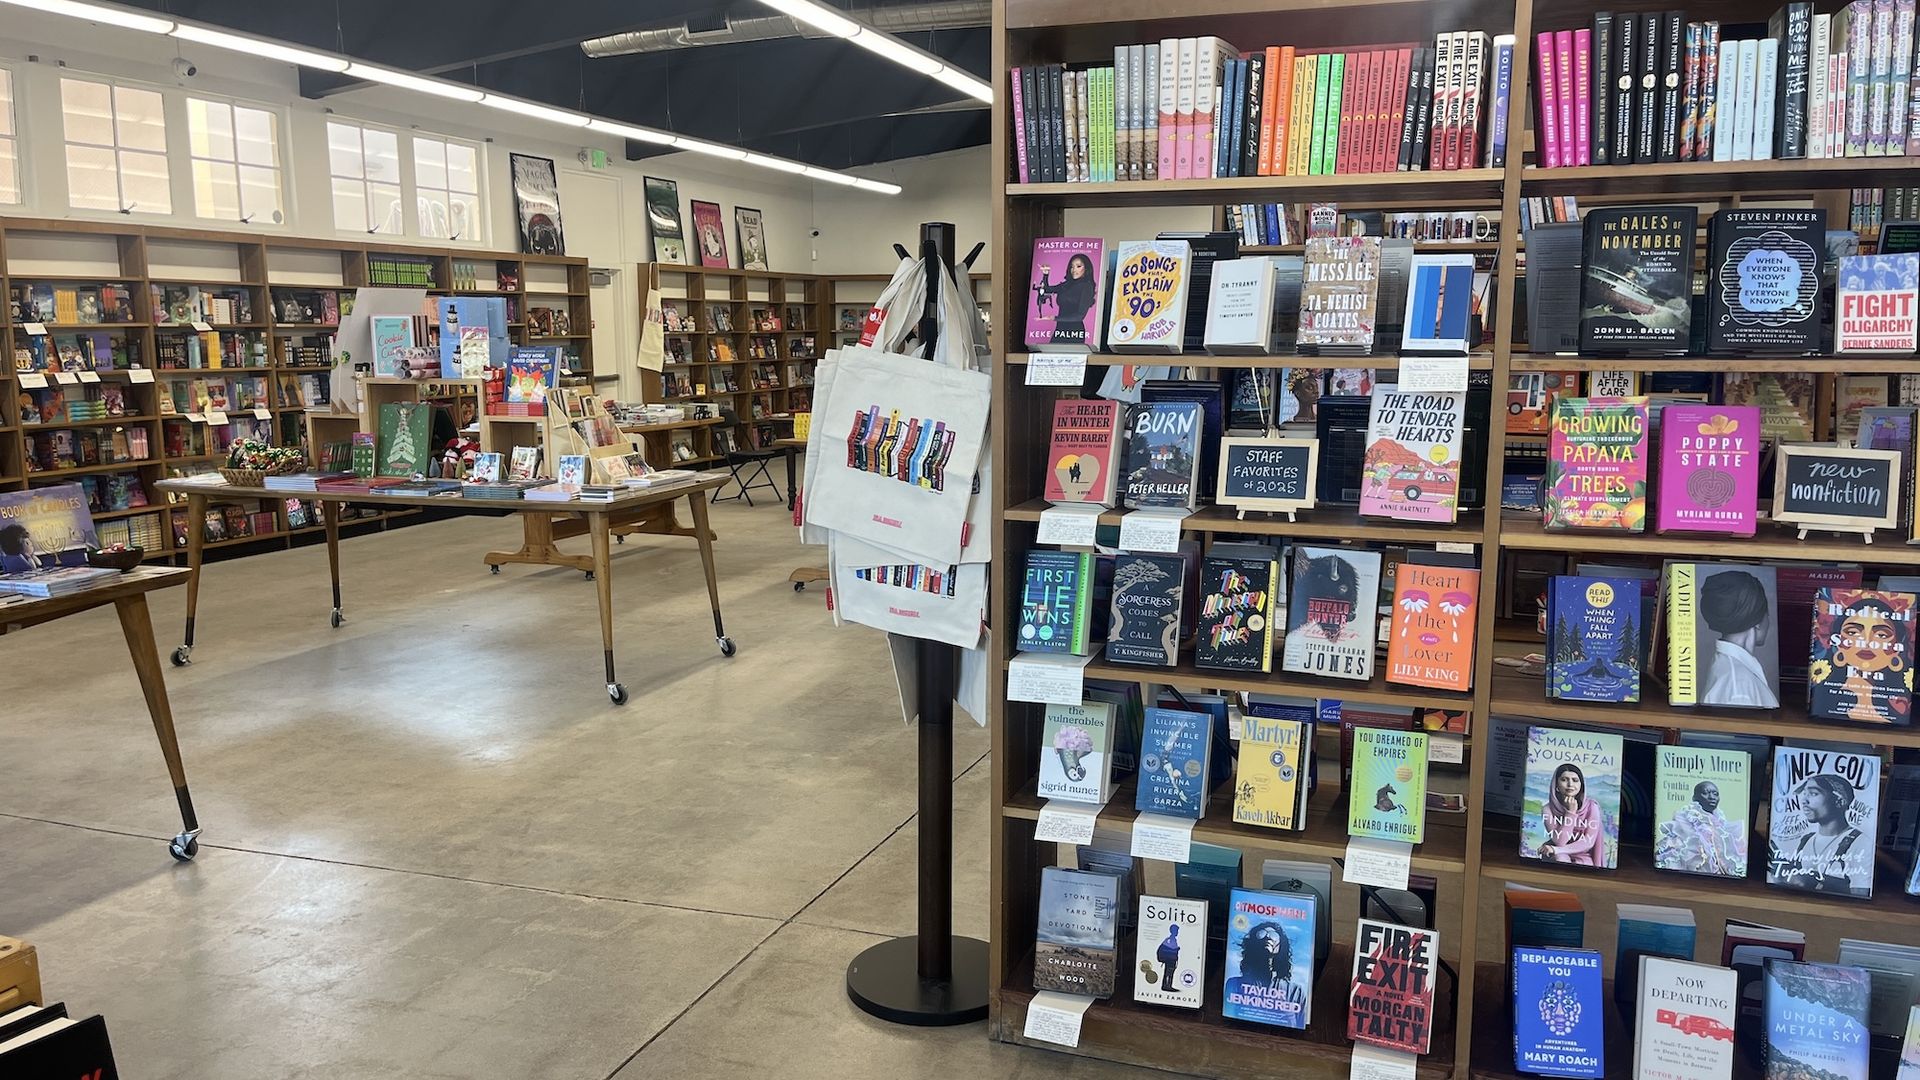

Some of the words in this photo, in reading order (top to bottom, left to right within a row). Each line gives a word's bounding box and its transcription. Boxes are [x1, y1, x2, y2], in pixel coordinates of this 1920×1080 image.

[1788, 21, 1808, 36] GOD
[1622, 47, 1630, 72] PINKER
[1500, 50, 1510, 90] SOLITO
[1604, 222, 1616, 230] THE
[1621, 216, 1668, 230] GALES
[1673, 221, 1682, 230] OF
[1727, 214, 1771, 222] STEVEN
[1775, 214, 1818, 222] PINKER
[1038, 242, 1070, 250] MASTER
[1086, 242, 1098, 250] ME
[1602, 234, 1682, 249] NOVEMBER
[1334, 248, 1349, 260] THE
[1122, 264, 1138, 278] 60
[1140, 256, 1177, 272] SONGS
[1307, 262, 1372, 282] MESSAGE
[1123, 276, 1174, 296] EXPLAIN
[1231, 280, 1258, 288] TYRANNY
[1307, 294, 1368, 312] TA-NEHISI
[1844, 294, 1914, 318] FIGHT
[1149, 318, 1166, 331] ROB
[1314, 312, 1358, 328] COATES
[1843, 319, 1913, 333] OLIGARCHY
[1029, 330, 1051, 338] KEKE
[1054, 330, 1090, 339] PALMER
[1842, 338, 1872, 348] BERNIE
[1874, 338, 1913, 348] SANDERS
[1598, 378, 1629, 388] AFTER
[1600, 388, 1626, 397] CARS
[1382, 394, 1410, 408] THE
[1412, 394, 1454, 411] ROAD
[1057, 418, 1070, 428] IN
[1070, 418, 1110, 428] WINTER
[1136, 410, 1196, 434] BURN
[1376, 410, 1396, 424] TO
[1399, 410, 1456, 428] TENDER
[1558, 415, 1642, 434] GROWING
[1054, 433, 1080, 442] KEVIN
[1081, 434, 1108, 443] BARRY
[1396, 426, 1454, 443] HEARTS
[1682, 436, 1744, 450] POPPY
[1246, 450, 1284, 463] STAFF
[1562, 445, 1634, 464] PAPAYA
[1682, 454, 1742, 468] STATE
[1233, 465, 1298, 479] FAVORITES
[1808, 462, 1876, 478] new
[1128, 484, 1154, 494] PETER
[1156, 484, 1188, 495] HELLER
[1570, 475, 1626, 494] TREES
[1792, 480, 1880, 506] nonfiction
[0, 504, 26, 519] BOOK
[1026, 568, 1074, 582] FIRST
[1412, 570, 1461, 589] Heart
[1808, 572, 1846, 580] MARSHA
[1024, 584, 1072, 609] LIE
[1588, 588, 1610, 596] READ
[1677, 569, 1692, 618] ZADIE
[1119, 593, 1172, 607] SORCERESS
[1308, 600, 1349, 612] BUFFALO
[1590, 596, 1610, 604] THIS
[1022, 610, 1070, 625] WINS
[1128, 608, 1160, 618] COMES
[1586, 608, 1615, 616] WHEN
[1828, 604, 1910, 622] Radical
[1417, 613, 1446, 630] the
[1584, 616, 1616, 624] THINGS
[1590, 624, 1609, 632] FALL
[1130, 631, 1152, 640] CALL
[1586, 632, 1613, 640] APART
[1122, 648, 1164, 660] KINGFISHER
[1404, 644, 1453, 664] Lover
[1304, 652, 1365, 676] JONES
[1678, 646, 1692, 696] SMITH
[1394, 663, 1422, 676] LILY
[1424, 668, 1460, 681] KING
[1846, 666, 1884, 680] Era
[1068, 706, 1084, 716] the
[1048, 714, 1105, 728] vulnerables
[1156, 718, 1196, 729] LILIANA'S
[1150, 728, 1200, 740] INVINCIBLE
[1243, 719, 1300, 749] Martyr!
[1359, 732, 1374, 743] YOU
[1376, 732, 1412, 747] DREAMED
[1414, 737, 1424, 748] OF
[1156, 739, 1192, 750] SUMMER
[1546, 736, 1603, 751] MALALA
[1373, 747, 1406, 760] EMPIRES
[1534, 748, 1614, 766] YOUSAFZAI
[1663, 752, 1706, 778] Simply
[1710, 754, 1742, 774] More
[1150, 776, 1190, 786] CRISTINA
[1776, 752, 1828, 796] ONLY
[1834, 754, 1874, 791] GOD
[1040, 780, 1068, 793] sigrid
[1068, 784, 1098, 796] nunez
[1154, 786, 1184, 796] RIVERA
[1663, 780, 1690, 792] Cynthia
[1154, 798, 1182, 808] GARZA
[1542, 814, 1598, 830] FINDING
[1544, 830, 1562, 840] MY
[1566, 832, 1594, 844] WAY
[1064, 893, 1090, 902] STONE
[1066, 908, 1086, 916] YARD
[1146, 906, 1197, 924] Solito
[1236, 902, 1307, 920] ATMOSPHERE
[1048, 921, 1103, 934] DEVOTIONAL
[1360, 924, 1432, 965] FIRE
[1048, 958, 1097, 970] CHARLOTTE
[1521, 953, 1598, 968] REPLACEABLE
[1060, 974, 1085, 984] WOOD
[1358, 956, 1428, 996] EXIT
[1548, 967, 1572, 978] YOU
[1675, 976, 1706, 990] NOW
[1242, 984, 1286, 1000] TAYLOR
[1652, 988, 1728, 1010] DEPARTING
[1227, 994, 1274, 1010] JENKINS
[1274, 1000, 1301, 1014] REID
[1353, 995, 1425, 1022] MORGAN
[1784, 1010, 1836, 1026] UNDER
[1844, 1016, 1854, 1030] A
[1353, 1012, 1424, 1045] TALTY
[1775, 1022, 1824, 1039] METAL
[1833, 1030, 1861, 1044] SKY
[1524, 1052, 1556, 1063] MARY
[1558, 1054, 1598, 1066] ROACH
